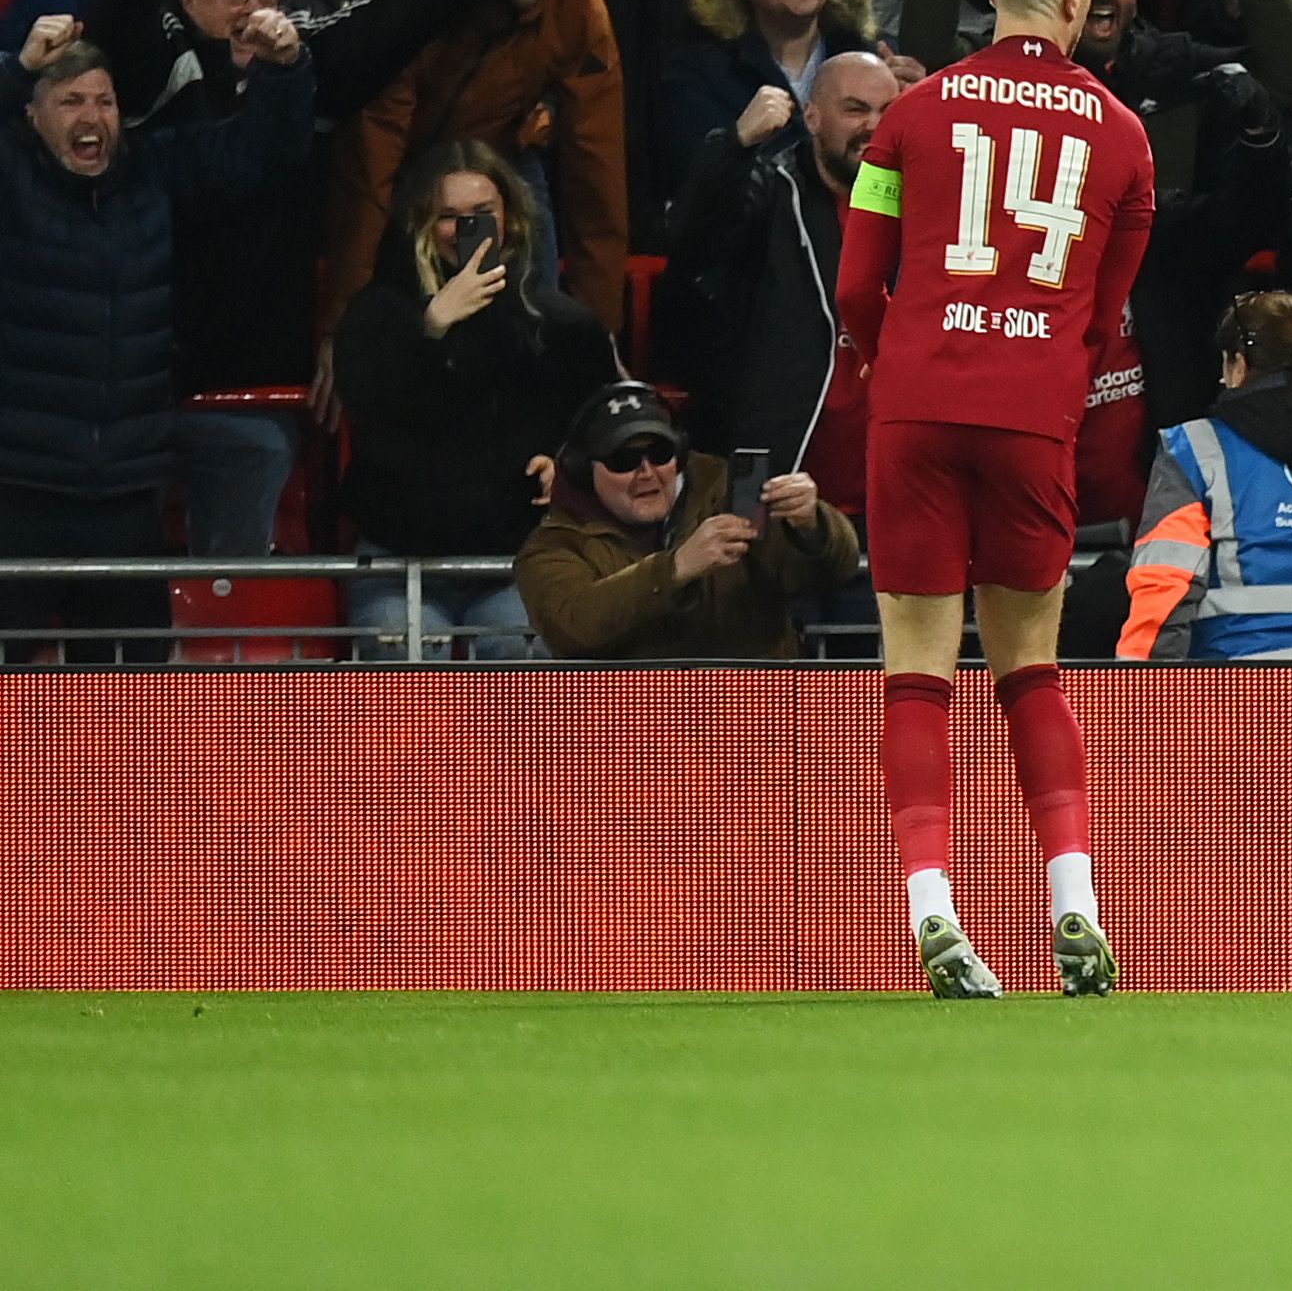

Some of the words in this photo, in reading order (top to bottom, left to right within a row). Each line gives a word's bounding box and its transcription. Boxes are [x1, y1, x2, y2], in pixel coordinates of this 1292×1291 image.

[942, 74, 1103, 124] HENDERSON
[945, 123, 1091, 290] 14
[943, 302, 988, 334] SIDE
[1004, 308, 1052, 339] SIDE
